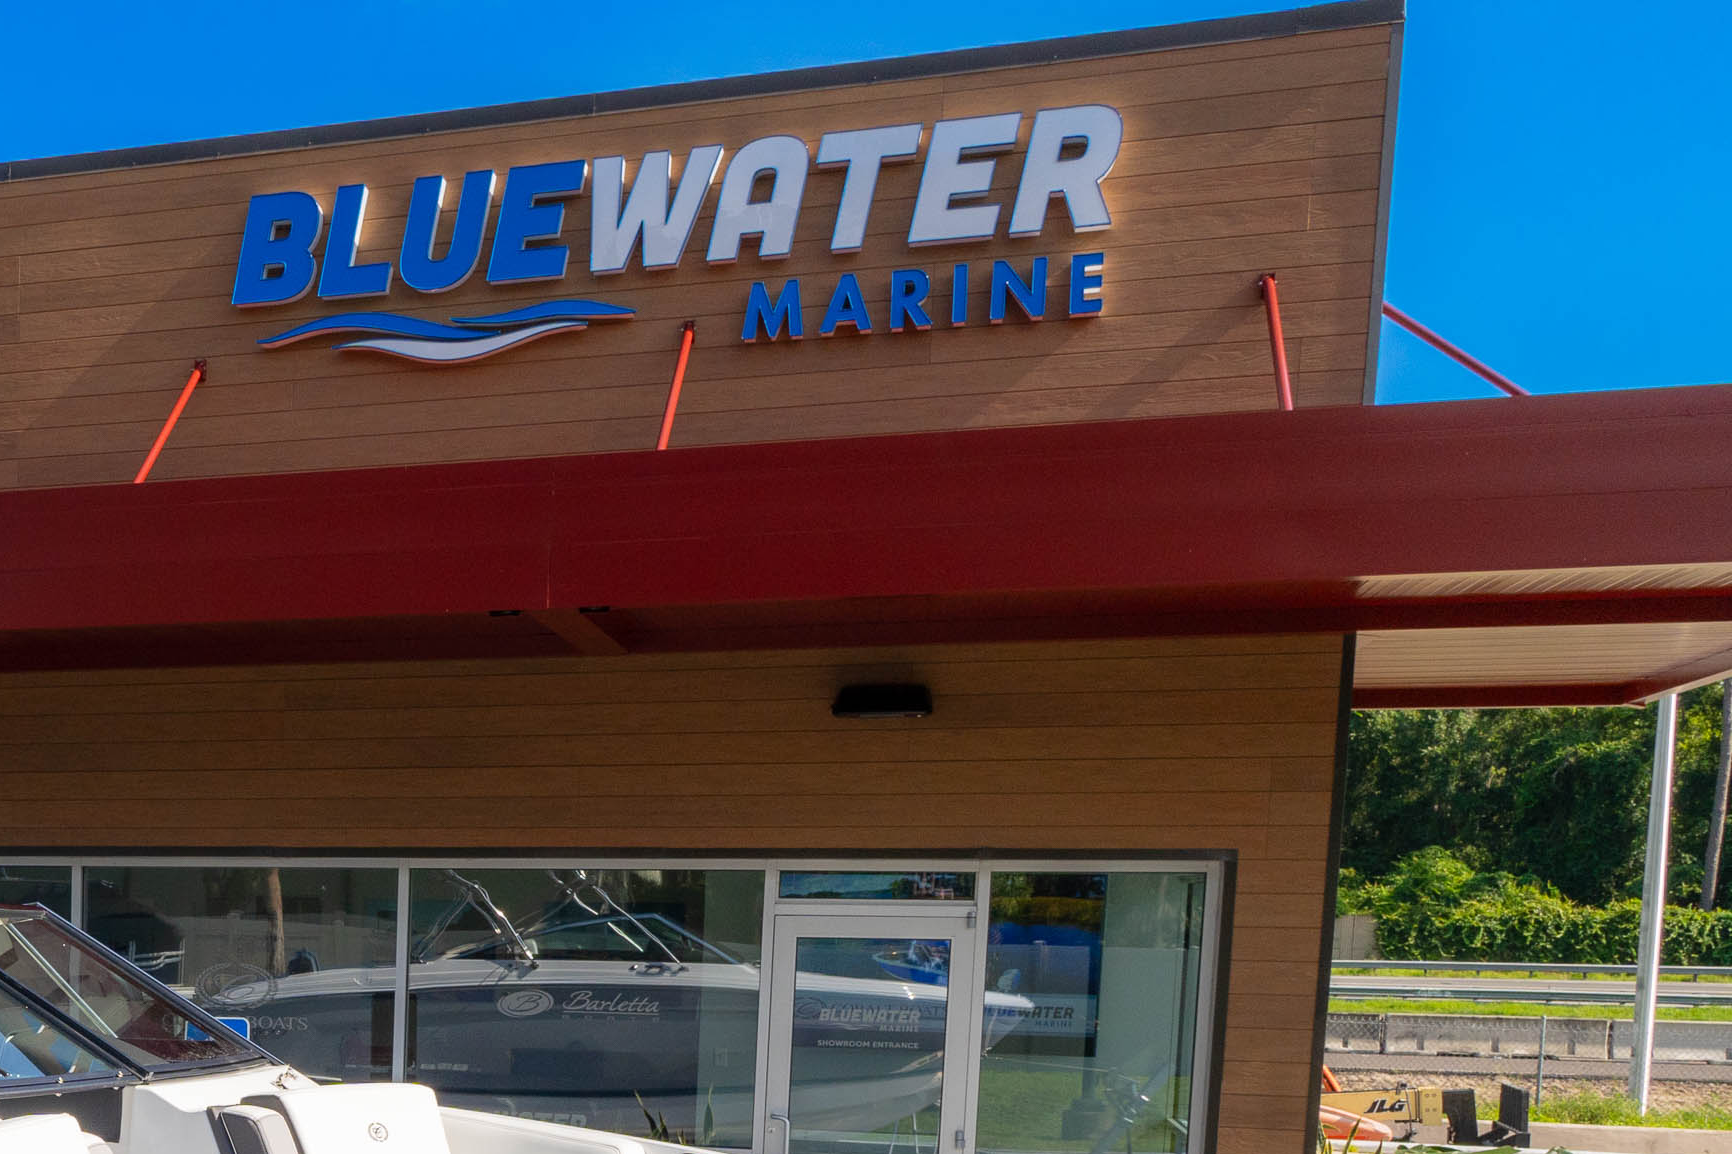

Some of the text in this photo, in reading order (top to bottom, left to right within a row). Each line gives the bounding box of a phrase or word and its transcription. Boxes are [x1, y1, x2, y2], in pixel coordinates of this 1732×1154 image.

[231, 103, 1124, 308] BLUEWATER
[741, 250, 1105, 344] MARINE
[563, 990, 660, 1013] Barletta
[819, 1008, 922, 1024] BLUEWATER
[879, 1025, 920, 1033] MARINE
[817, 1039, 921, 1049] SHOWROOM ENTRANCE
[1363, 1098, 1407, 1114] JLG
